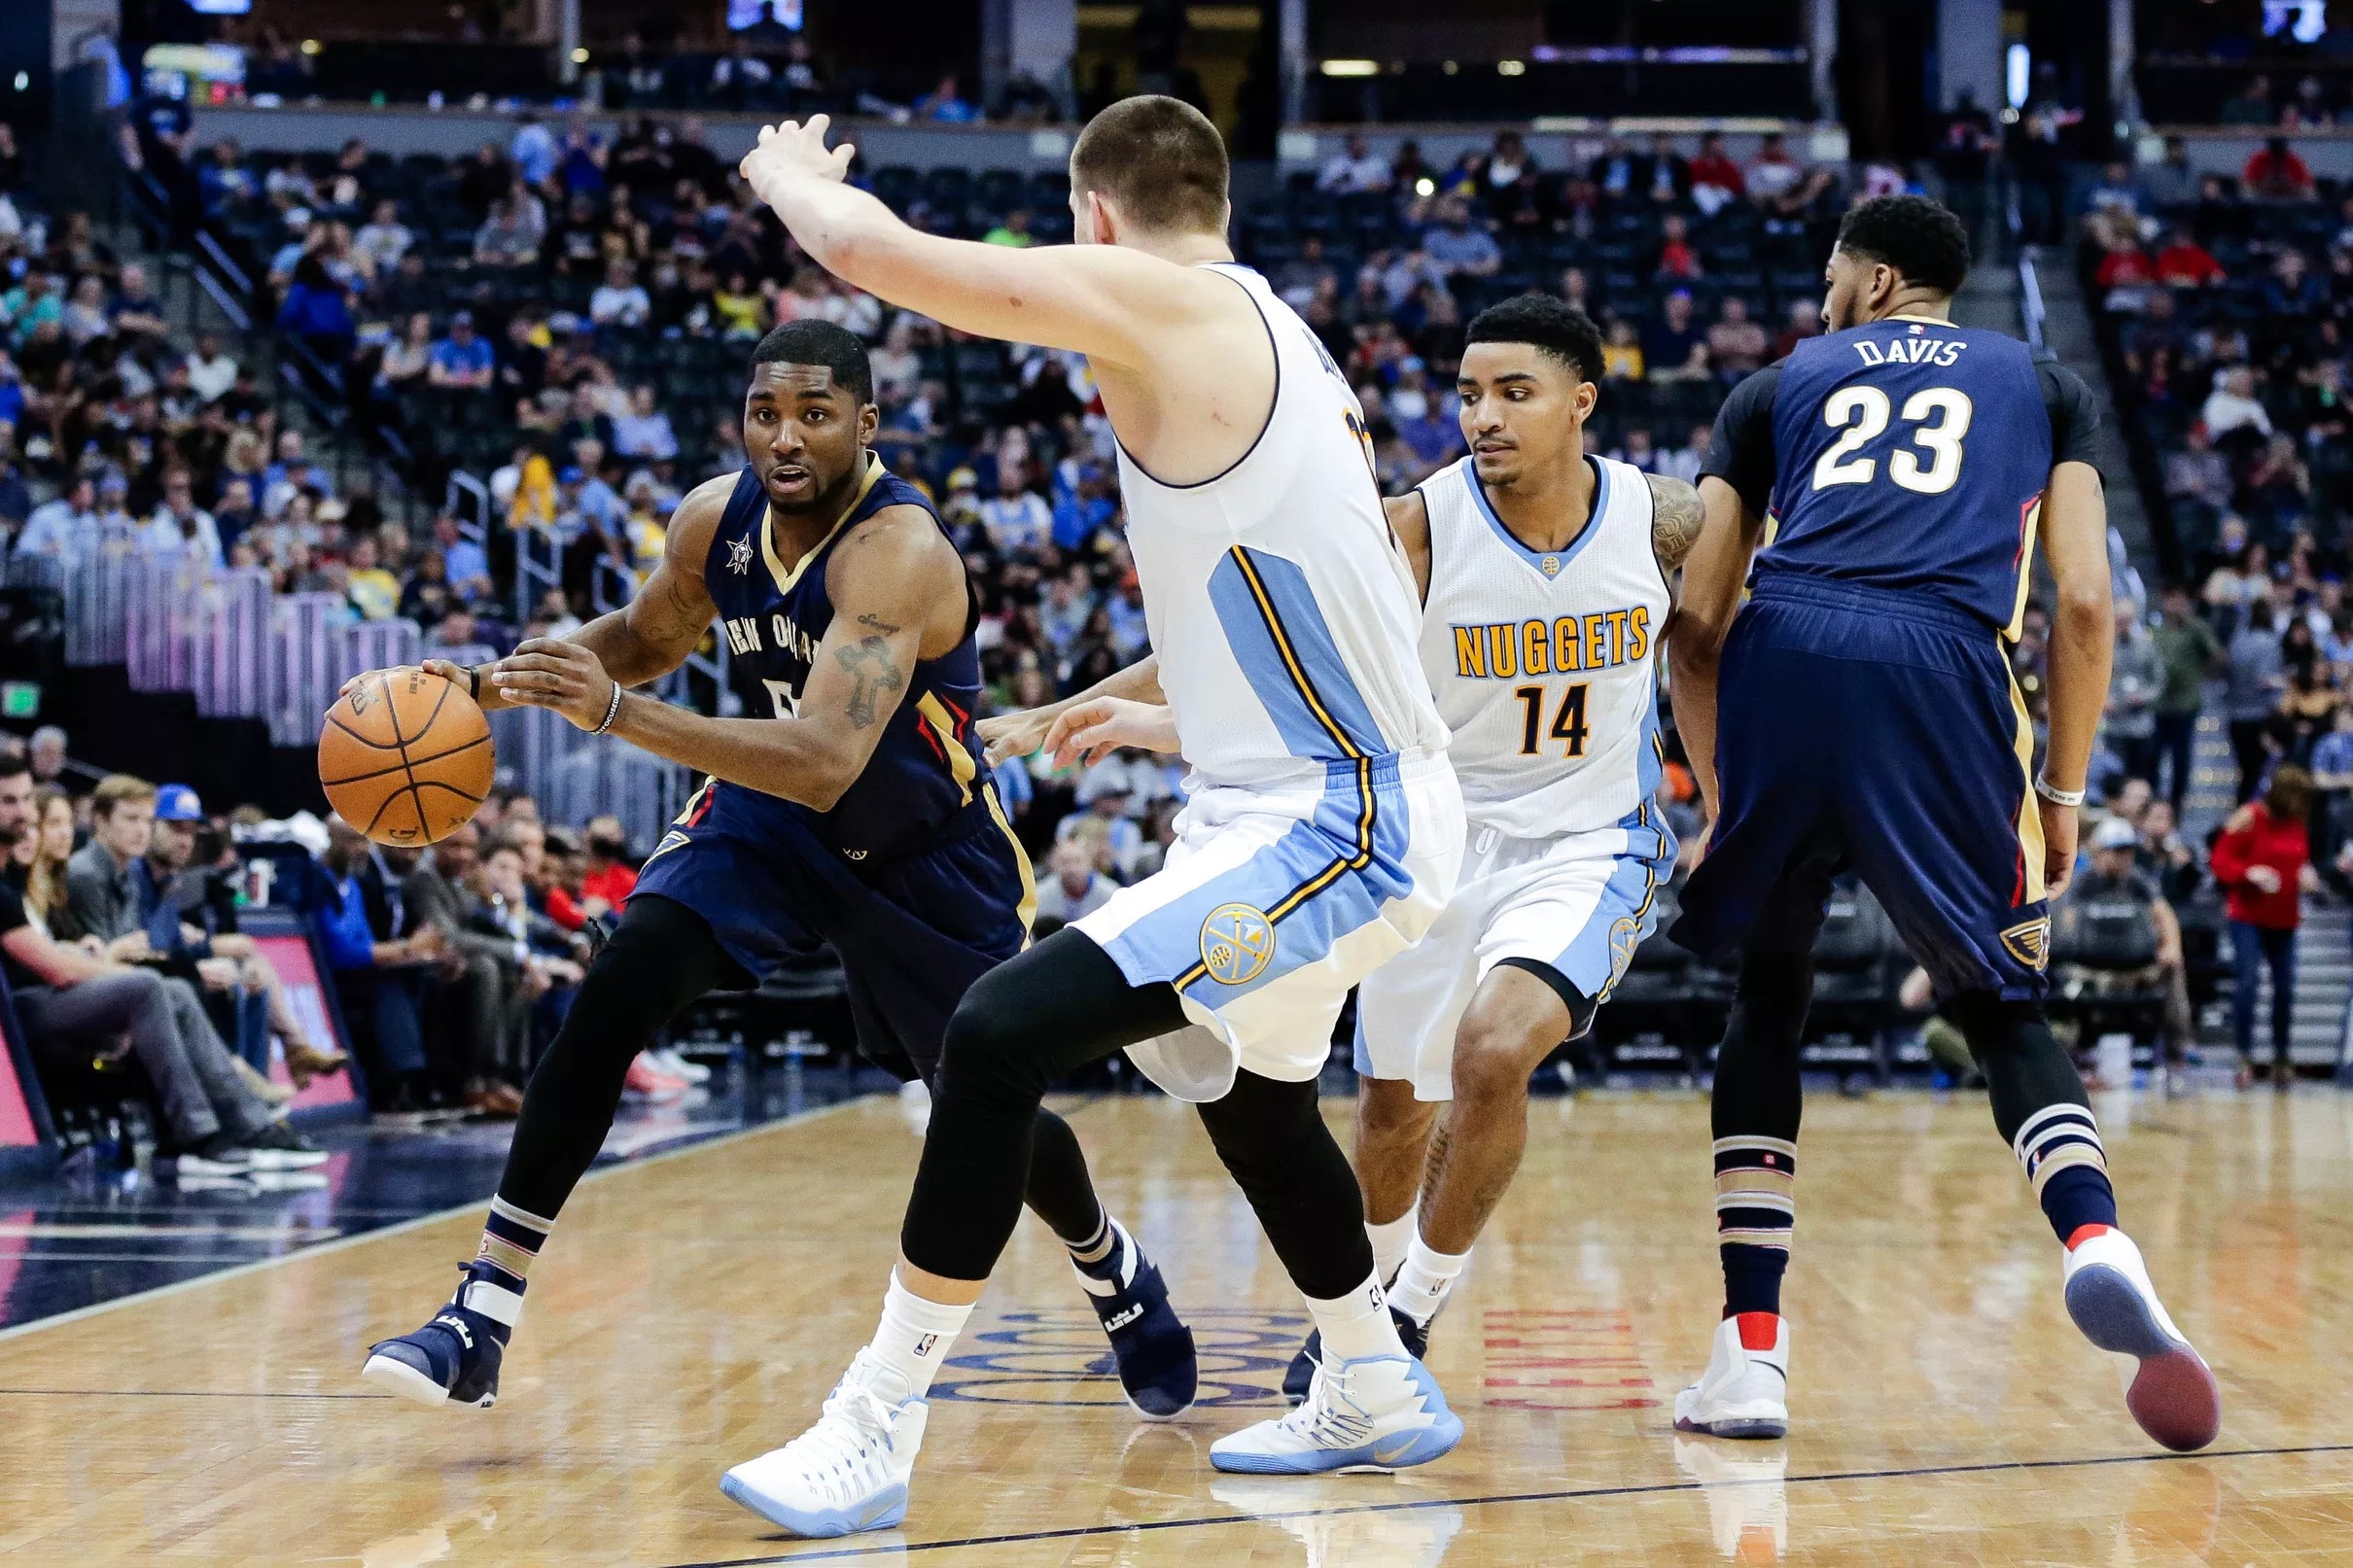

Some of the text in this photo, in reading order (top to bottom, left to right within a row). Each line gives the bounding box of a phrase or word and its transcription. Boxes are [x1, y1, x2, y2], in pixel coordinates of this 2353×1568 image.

[1853, 339, 1968, 366] DAVIS
[1812, 385, 1973, 494] 23
[1450, 605, 1651, 679] NUGGETS
[1514, 681, 1592, 758] 14
